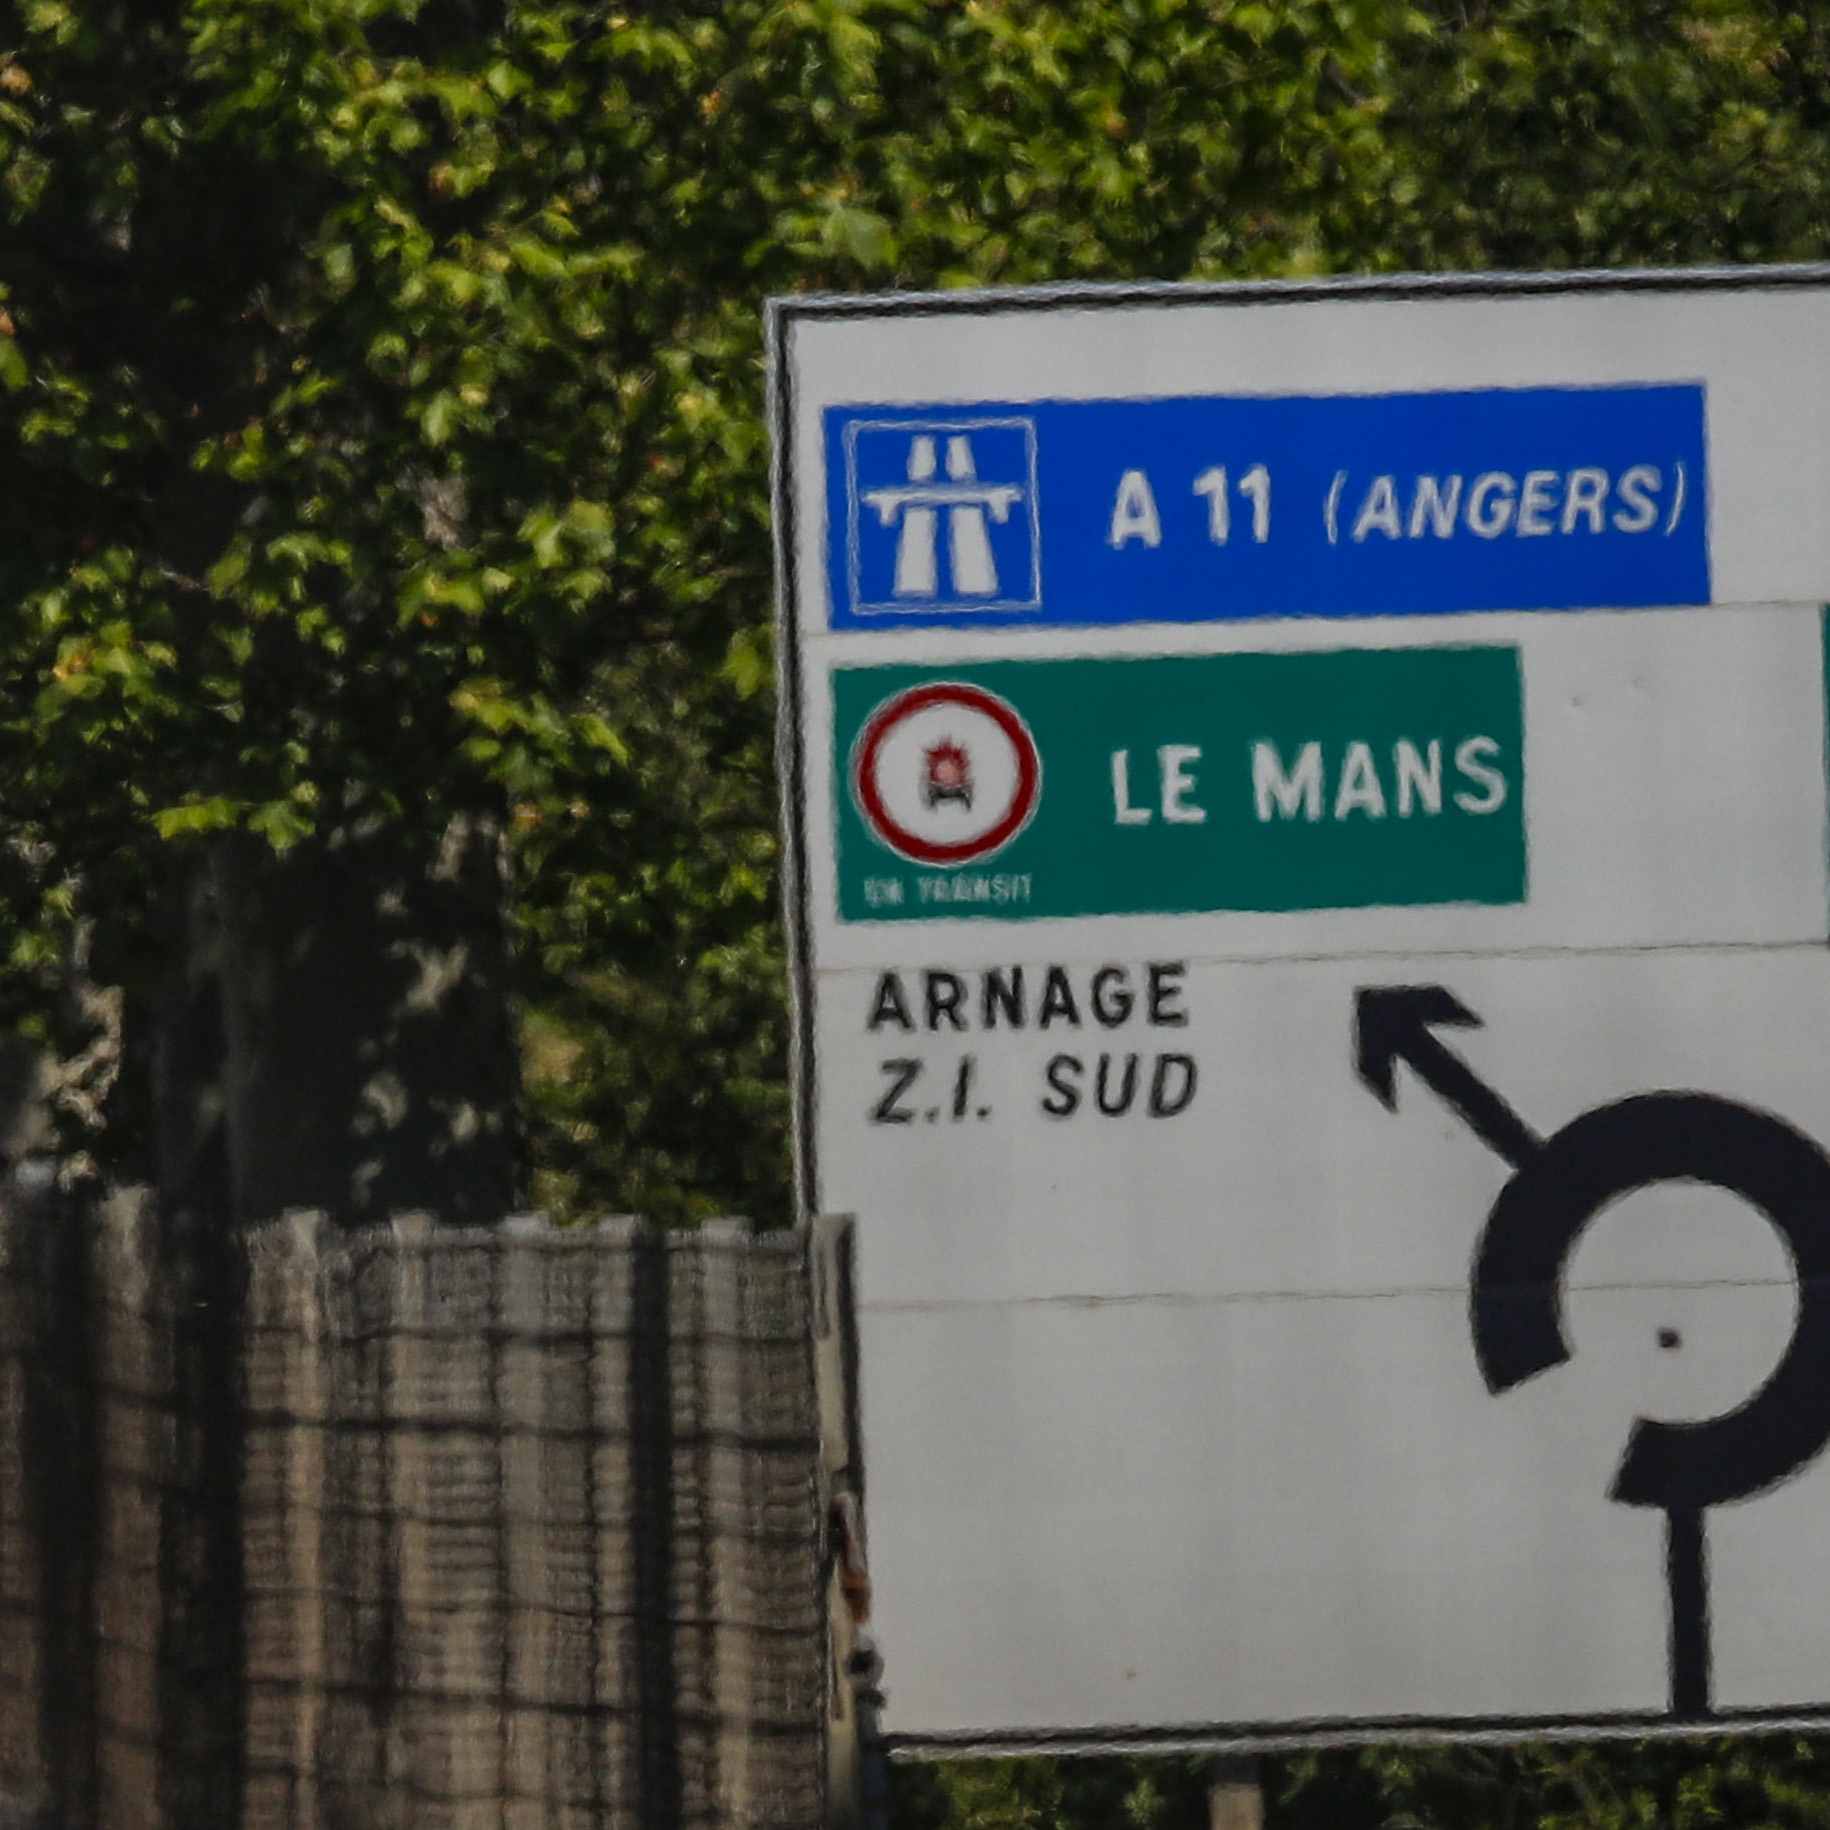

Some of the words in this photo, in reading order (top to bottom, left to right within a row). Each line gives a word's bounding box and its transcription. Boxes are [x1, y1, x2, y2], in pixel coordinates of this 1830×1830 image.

[1107, 469, 1161, 549] A
[1192, 465, 1272, 545] 11
[1324, 459, 1686, 541] (ANGERS)
[1110, 744, 1207, 826] LE
[1250, 735, 1509, 824] MANS
[867, 963, 1191, 1031] ARNAGE
[867, 1060, 991, 1125] Z.I.
[1040, 1055, 1199, 1118] SUD
